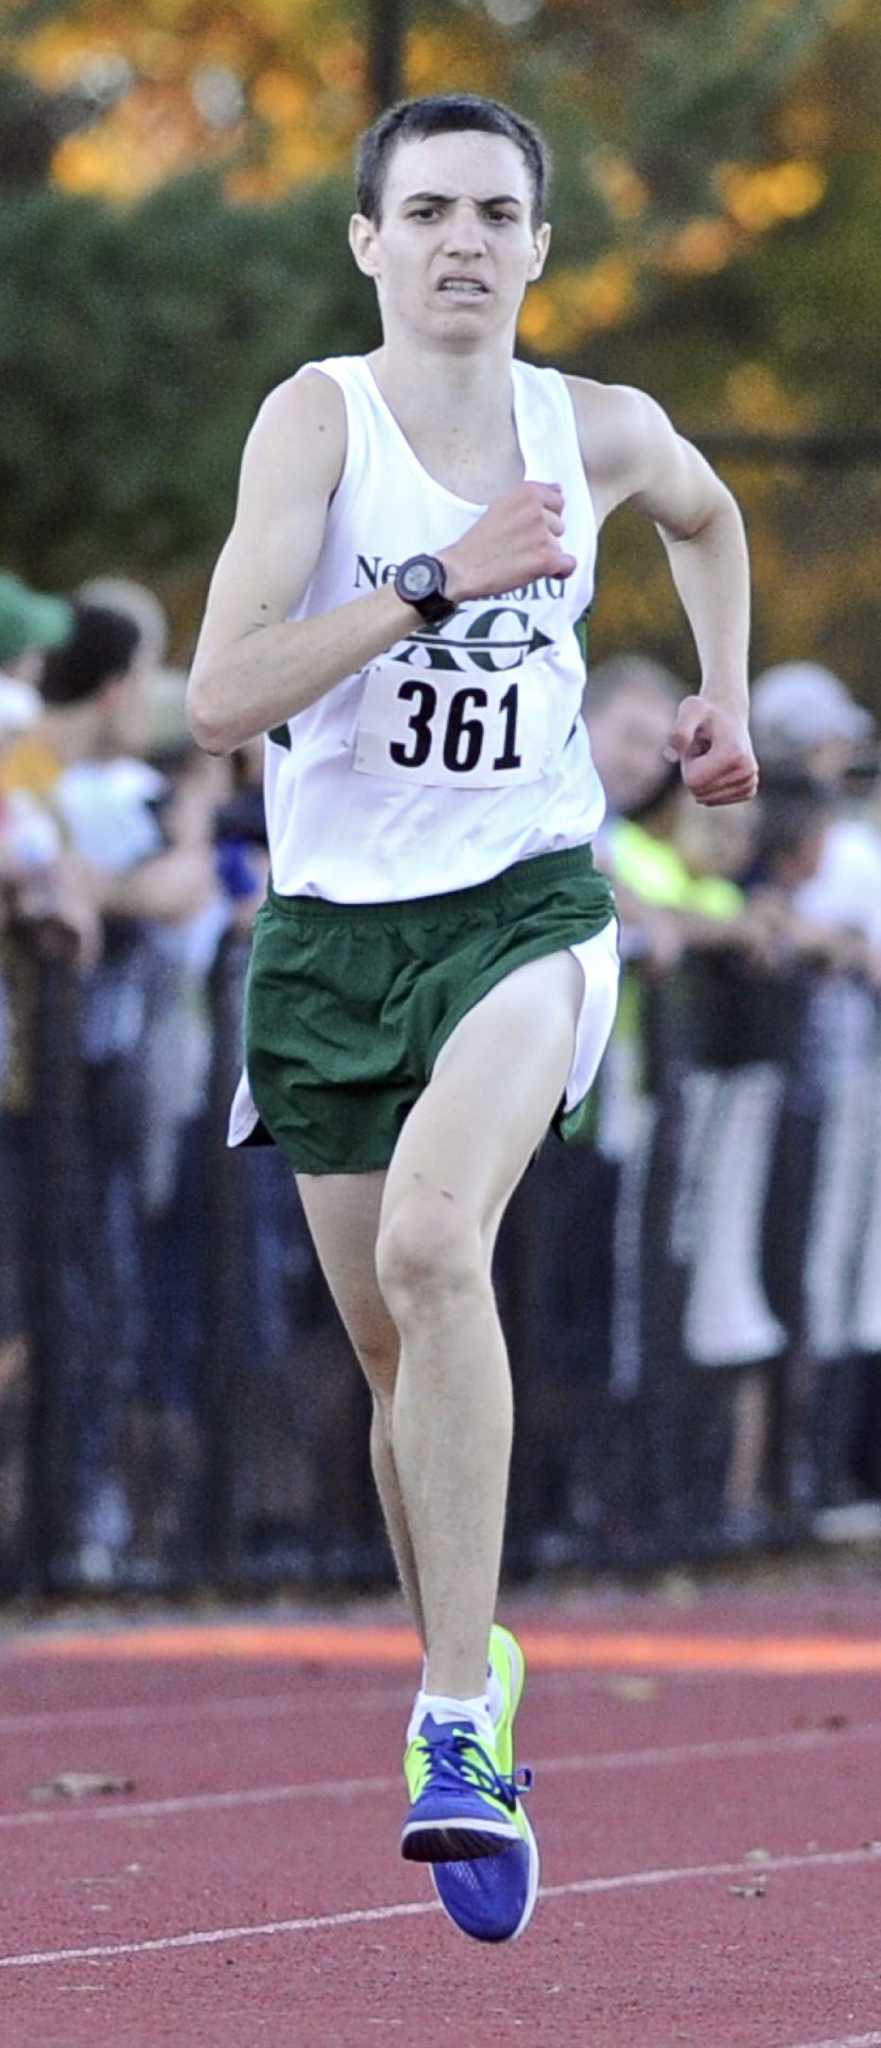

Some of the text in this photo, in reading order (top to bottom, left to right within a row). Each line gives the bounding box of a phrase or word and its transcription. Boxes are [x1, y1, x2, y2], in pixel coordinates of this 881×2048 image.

[353, 554, 400, 589] Ne
[390, 607, 529, 672] XC
[389, 679, 522, 773] 361
